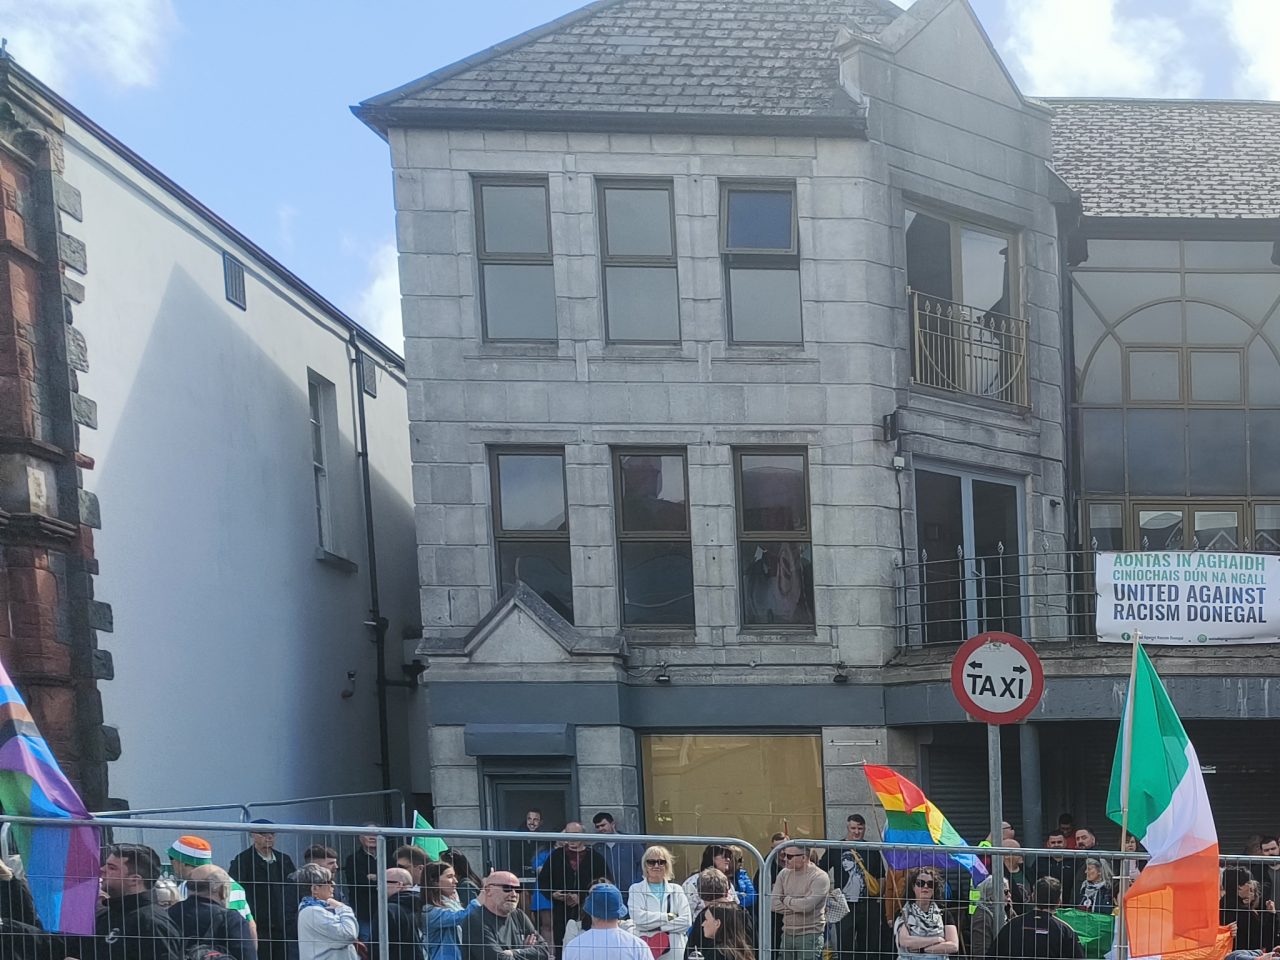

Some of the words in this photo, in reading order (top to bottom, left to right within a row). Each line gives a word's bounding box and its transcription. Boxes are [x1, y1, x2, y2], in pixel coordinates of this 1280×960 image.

[1176, 553, 1191, 567] IN
[1197, 554, 1265, 571] AGHAIDH
[1184, 569, 1208, 582] DÚN
[1212, 571, 1227, 583] NA
[1231, 573, 1267, 585] NGALL
[1113, 583, 1179, 602] UNITED
[1186, 585, 1267, 604] AGAINST
[1113, 603, 1180, 621] RACISM
[1187, 605, 1267, 623] DONEGAL
[967, 674, 1024, 699] TAXI
